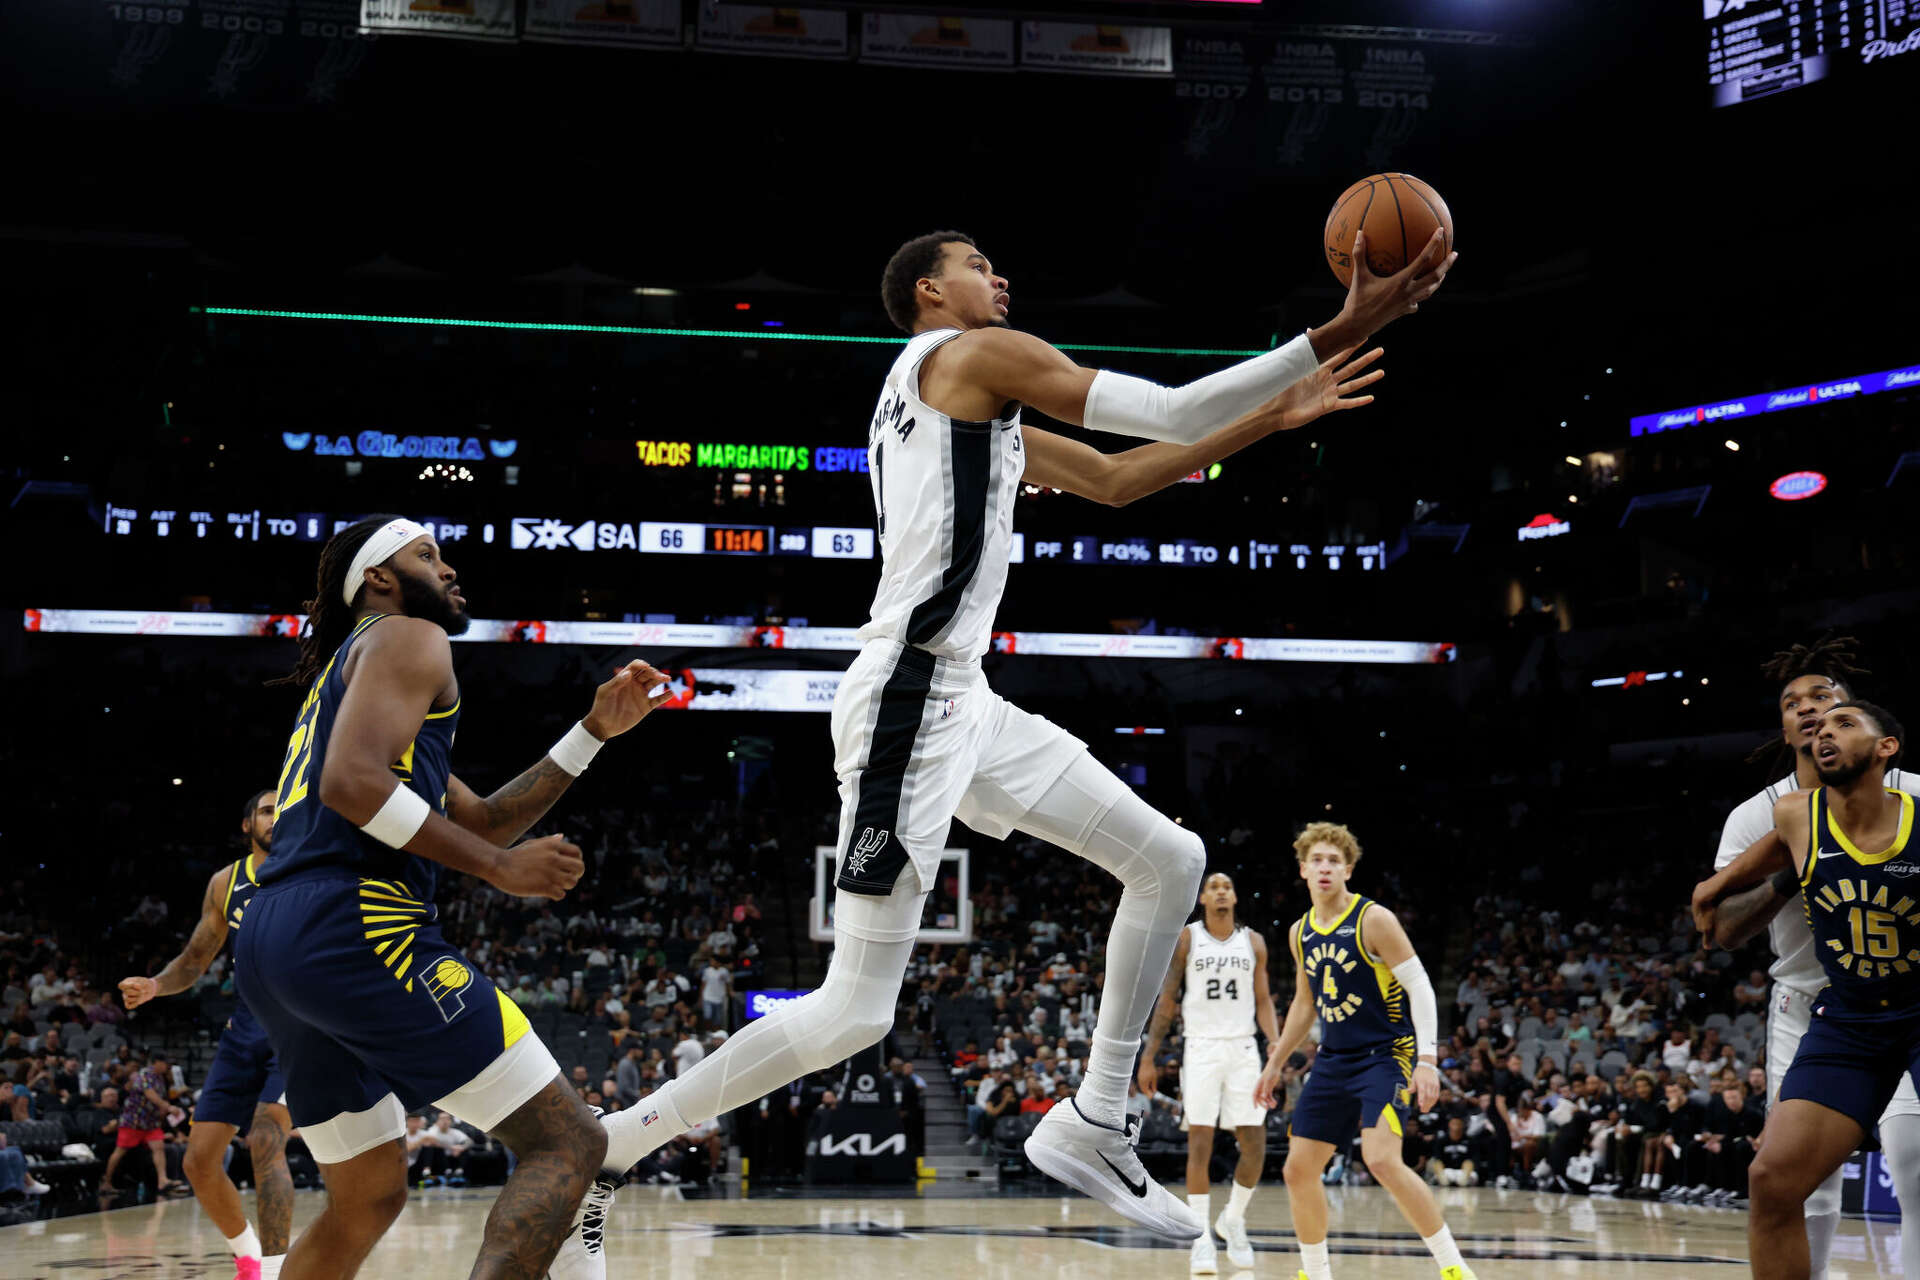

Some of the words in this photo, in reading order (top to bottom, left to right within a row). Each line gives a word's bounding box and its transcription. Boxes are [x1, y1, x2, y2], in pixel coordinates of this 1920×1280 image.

[314, 434, 354, 456] LA
[356, 430, 486, 460] GLORIA
[636, 440, 692, 468] TACOS
[696, 442, 809, 471] MARGARITAS
[266, 518, 297, 537] TO
[439, 523, 469, 542] PF
[597, 522, 638, 550] SA
[660, 529, 684, 549] 66
[713, 529, 765, 552] 11:14
[832, 533, 855, 554] 63
[1034, 541, 1062, 558] PF
[1101, 543, 1151, 561] FG%
[1189, 545, 1219, 563] TO
[1813, 878, 1920, 927] INDIANA
[1847, 906, 1900, 958] 15
[1195, 955, 1251, 974] SPURS
[1305, 942, 1358, 978] INDIANA
[1206, 978, 1239, 1001] 24
[1322, 964, 1339, 1000] 4
